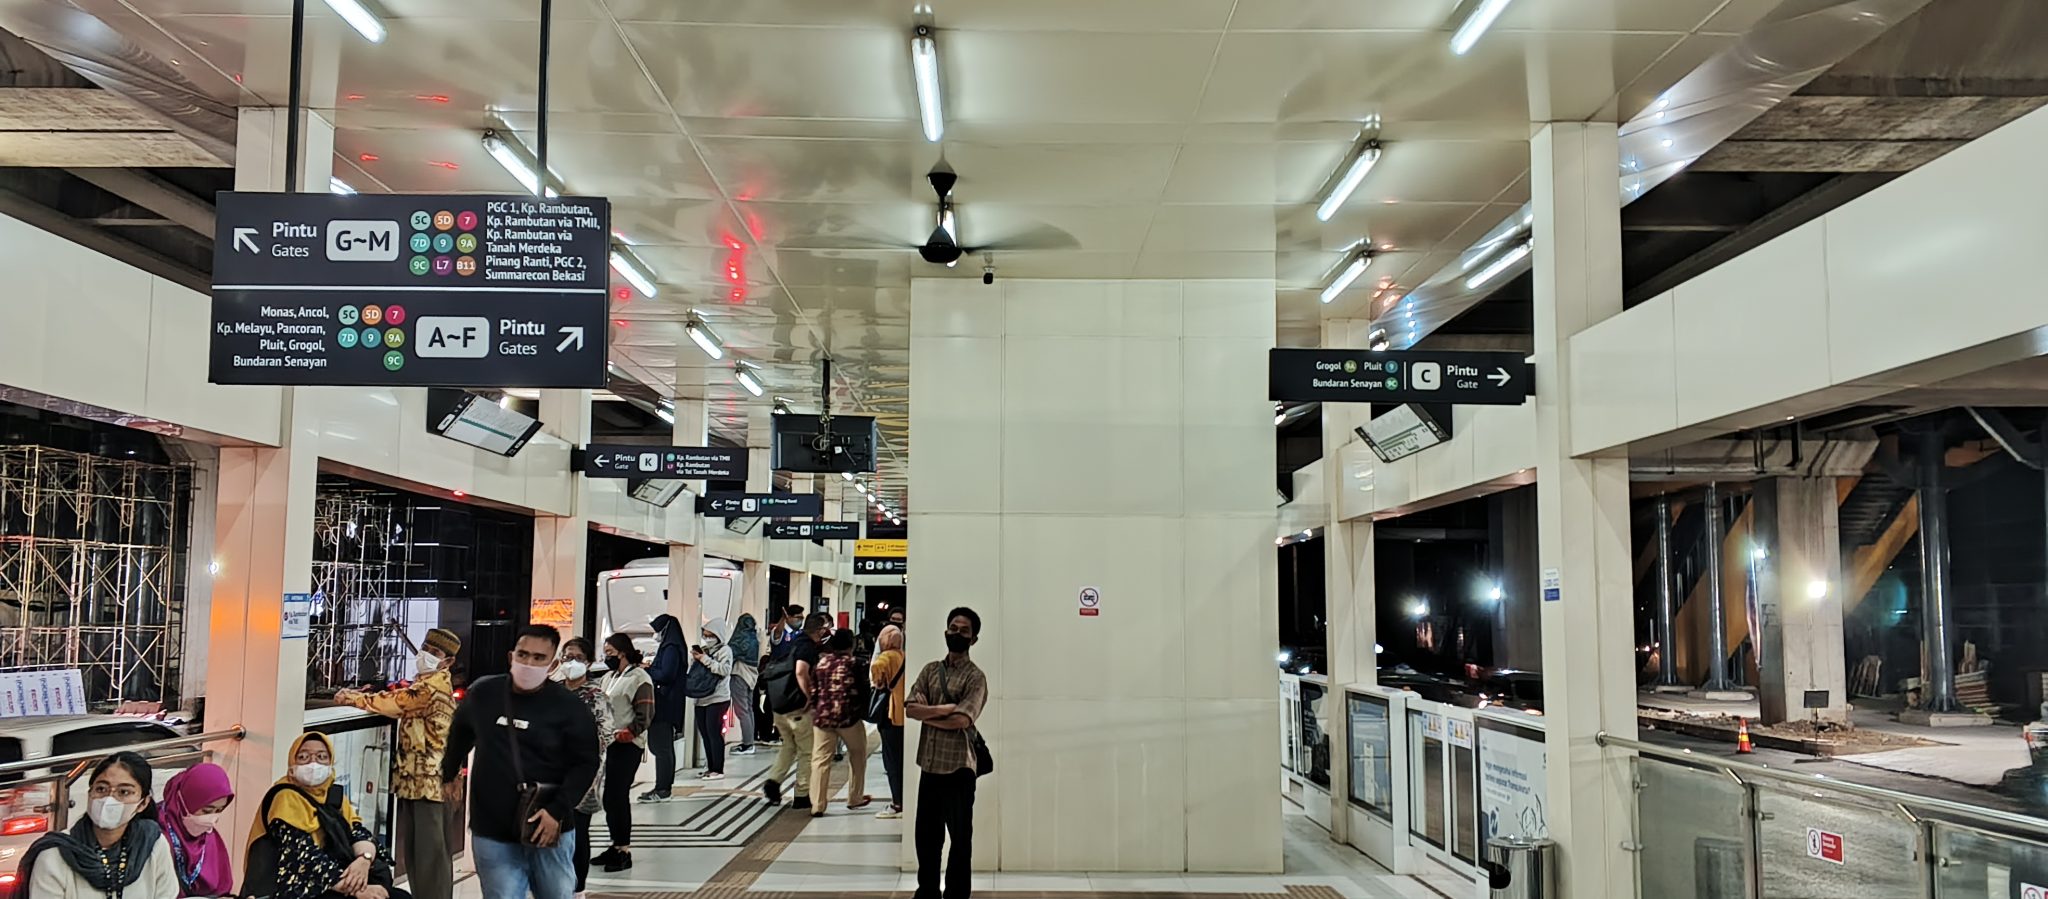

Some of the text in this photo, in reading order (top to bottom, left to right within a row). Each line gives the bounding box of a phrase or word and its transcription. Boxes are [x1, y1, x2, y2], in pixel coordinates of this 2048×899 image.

[487, 202, 593, 216] PGC 1, Kp. Rambutan,
[415, 216, 471, 225] 5C 5D 7
[486, 215, 601, 230] Kp. Rambutan via TMII,
[272, 222, 317, 238] Pintu
[486, 228, 573, 242] Kp. Rambutan via
[336, 230, 390, 252] G~M
[413, 238, 473, 248] 7D 9 9A
[272, 244, 310, 258] Gates
[486, 242, 562, 254] Tanah Merdeka
[413, 260, 475, 270] 9C L7 B11
[486, 255, 587, 270] Pinang Ranti, PGC 2,
[486, 268, 586, 282] Summarecon Bekasi
[260, 306, 330, 319] Monas, Ancol,
[342, 310, 399, 320] 5C 5D 7
[216, 322, 326, 336] Kp. Melayu, Pancoran,
[500, 319, 545, 336] Pintu
[341, 334, 401, 343] 7D 9 9A
[428, 326, 476, 348] A~F
[260, 339, 326, 353] Pluit, Grogol,
[499, 342, 538, 355] Gates
[233, 355, 327, 370] Bundaran Senayan
[387, 356, 400, 366] 9C
[1316, 361, 1342, 374] Grogol
[1364, 362, 1382, 371] Pluit
[1388, 362, 1394, 371] 9
[1421, 369, 1431, 383] C
[1446, 365, 1478, 376] Pintu
[1312, 378, 1349, 388] Bundaran
[1350, 379, 1383, 391] Senayan
[1456, 380, 1478, 389] Gate
[614, 454, 636, 462] Pintu
[644, 458, 652, 467] K
